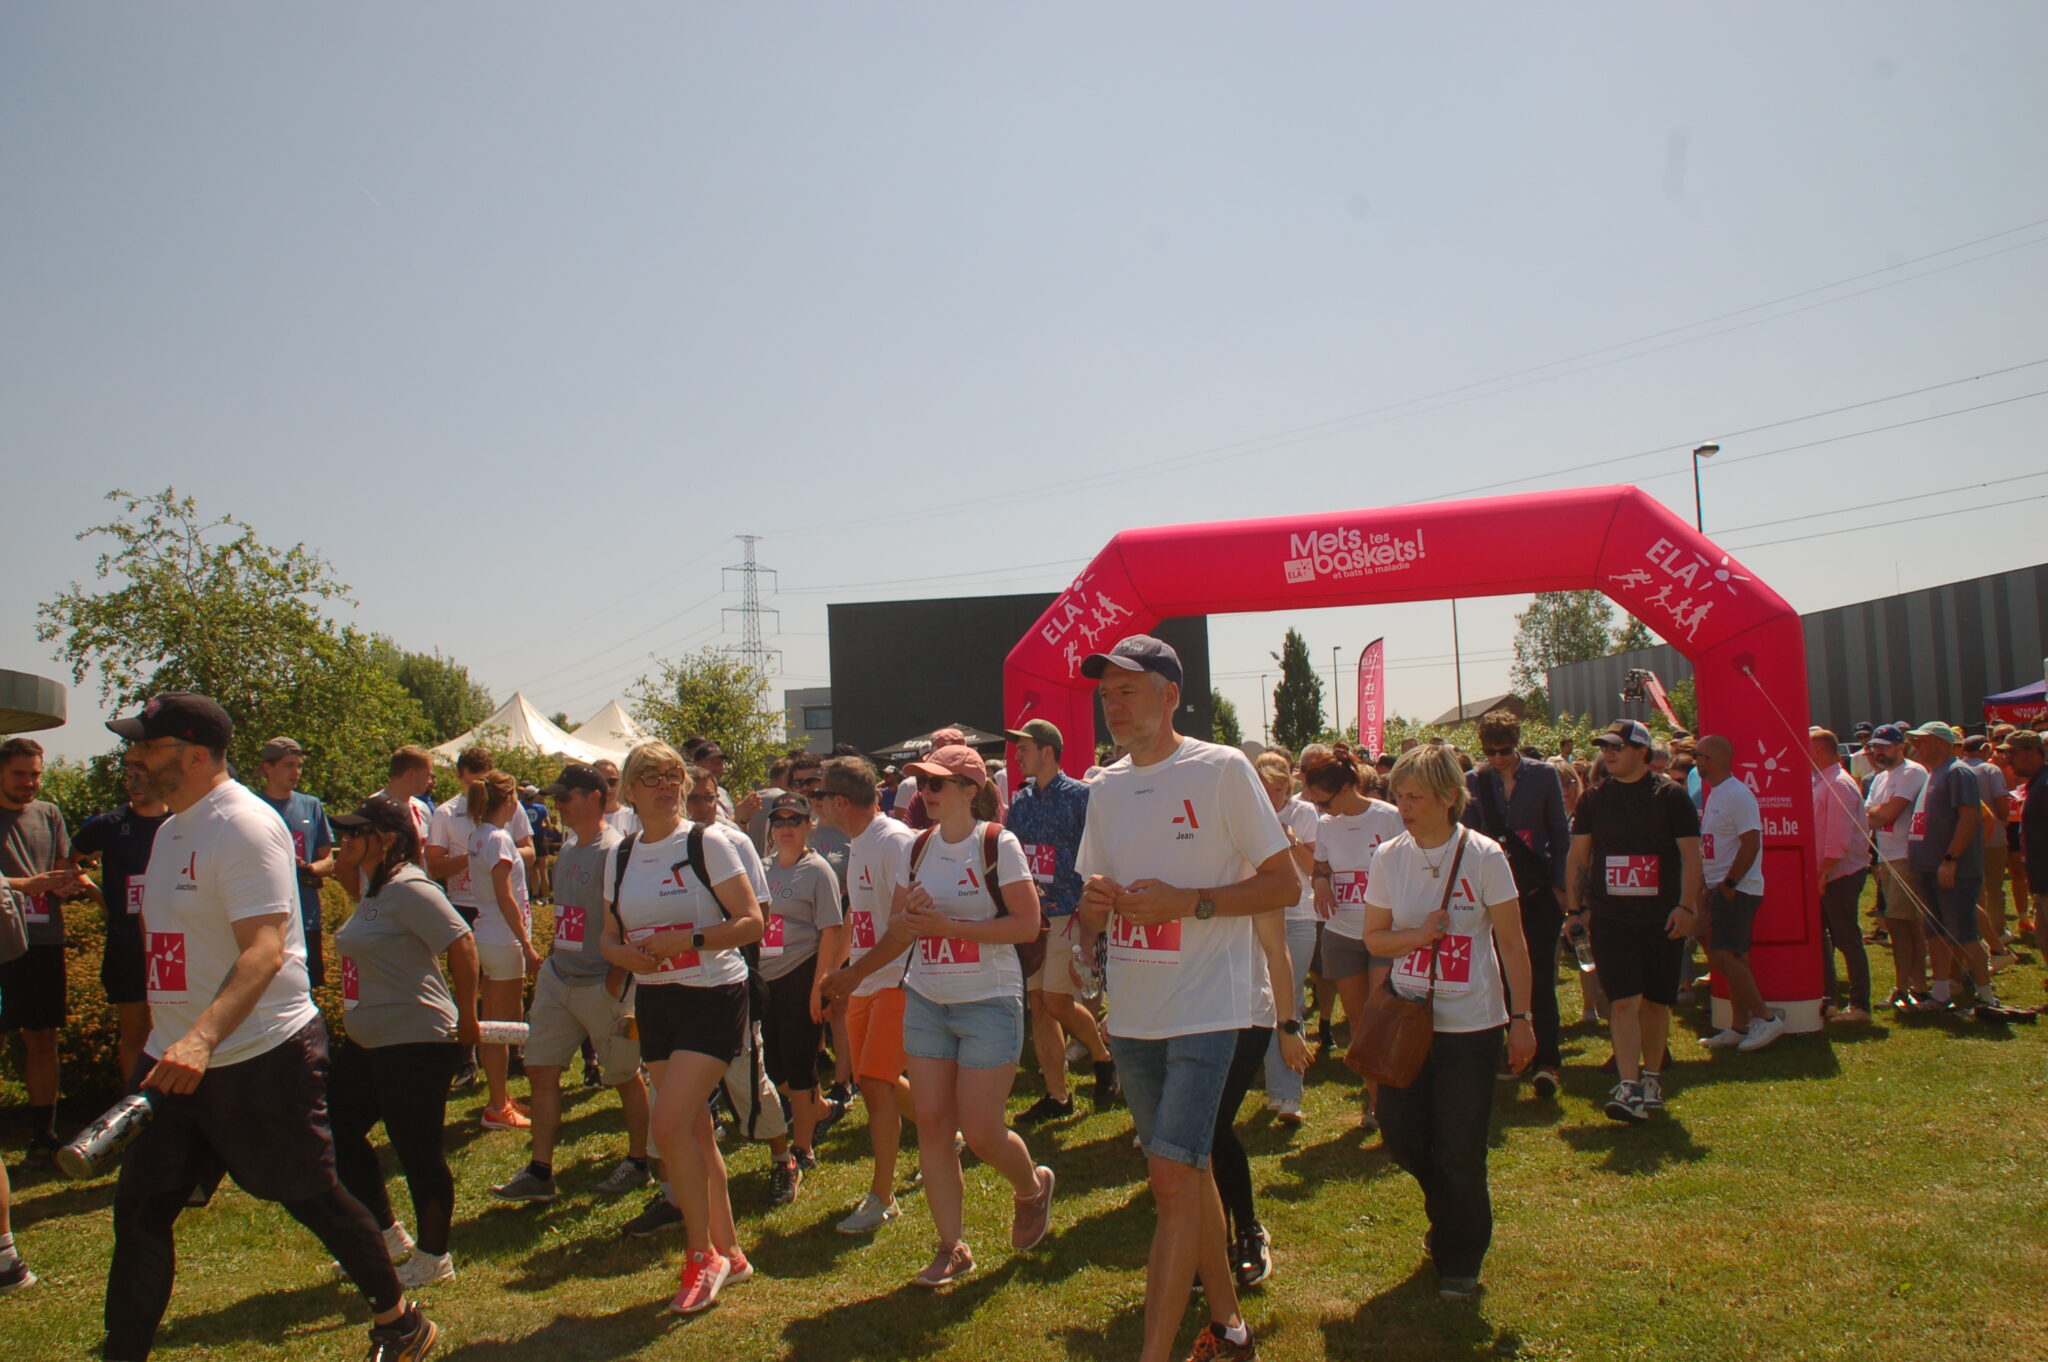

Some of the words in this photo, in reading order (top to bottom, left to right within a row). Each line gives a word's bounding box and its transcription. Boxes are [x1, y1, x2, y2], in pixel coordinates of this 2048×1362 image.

[1290, 526, 1362, 558] Mets
[1369, 532, 1390, 545] tes
[1314, 528, 1426, 574] baskets!
[1343, 569, 1363, 578] bats
[1365, 566, 1374, 575] la
[1375, 561, 1411, 573] maladie
[1645, 537, 1699, 589] ELA
[1041, 602, 1084, 646] ELA
[1366, 725, 1380, 761] spoir
[1176, 832, 1194, 840] Jean
[1761, 816, 1799, 835] la.be
[1606, 868, 1641, 887] ELA
[659, 888, 688, 897] Sandrine
[1334, 884, 1363, 903] ELA
[1453, 903, 1475, 911] Ariane
[1110, 913, 1149, 949] ELA
[919, 938, 956, 964] ELA
